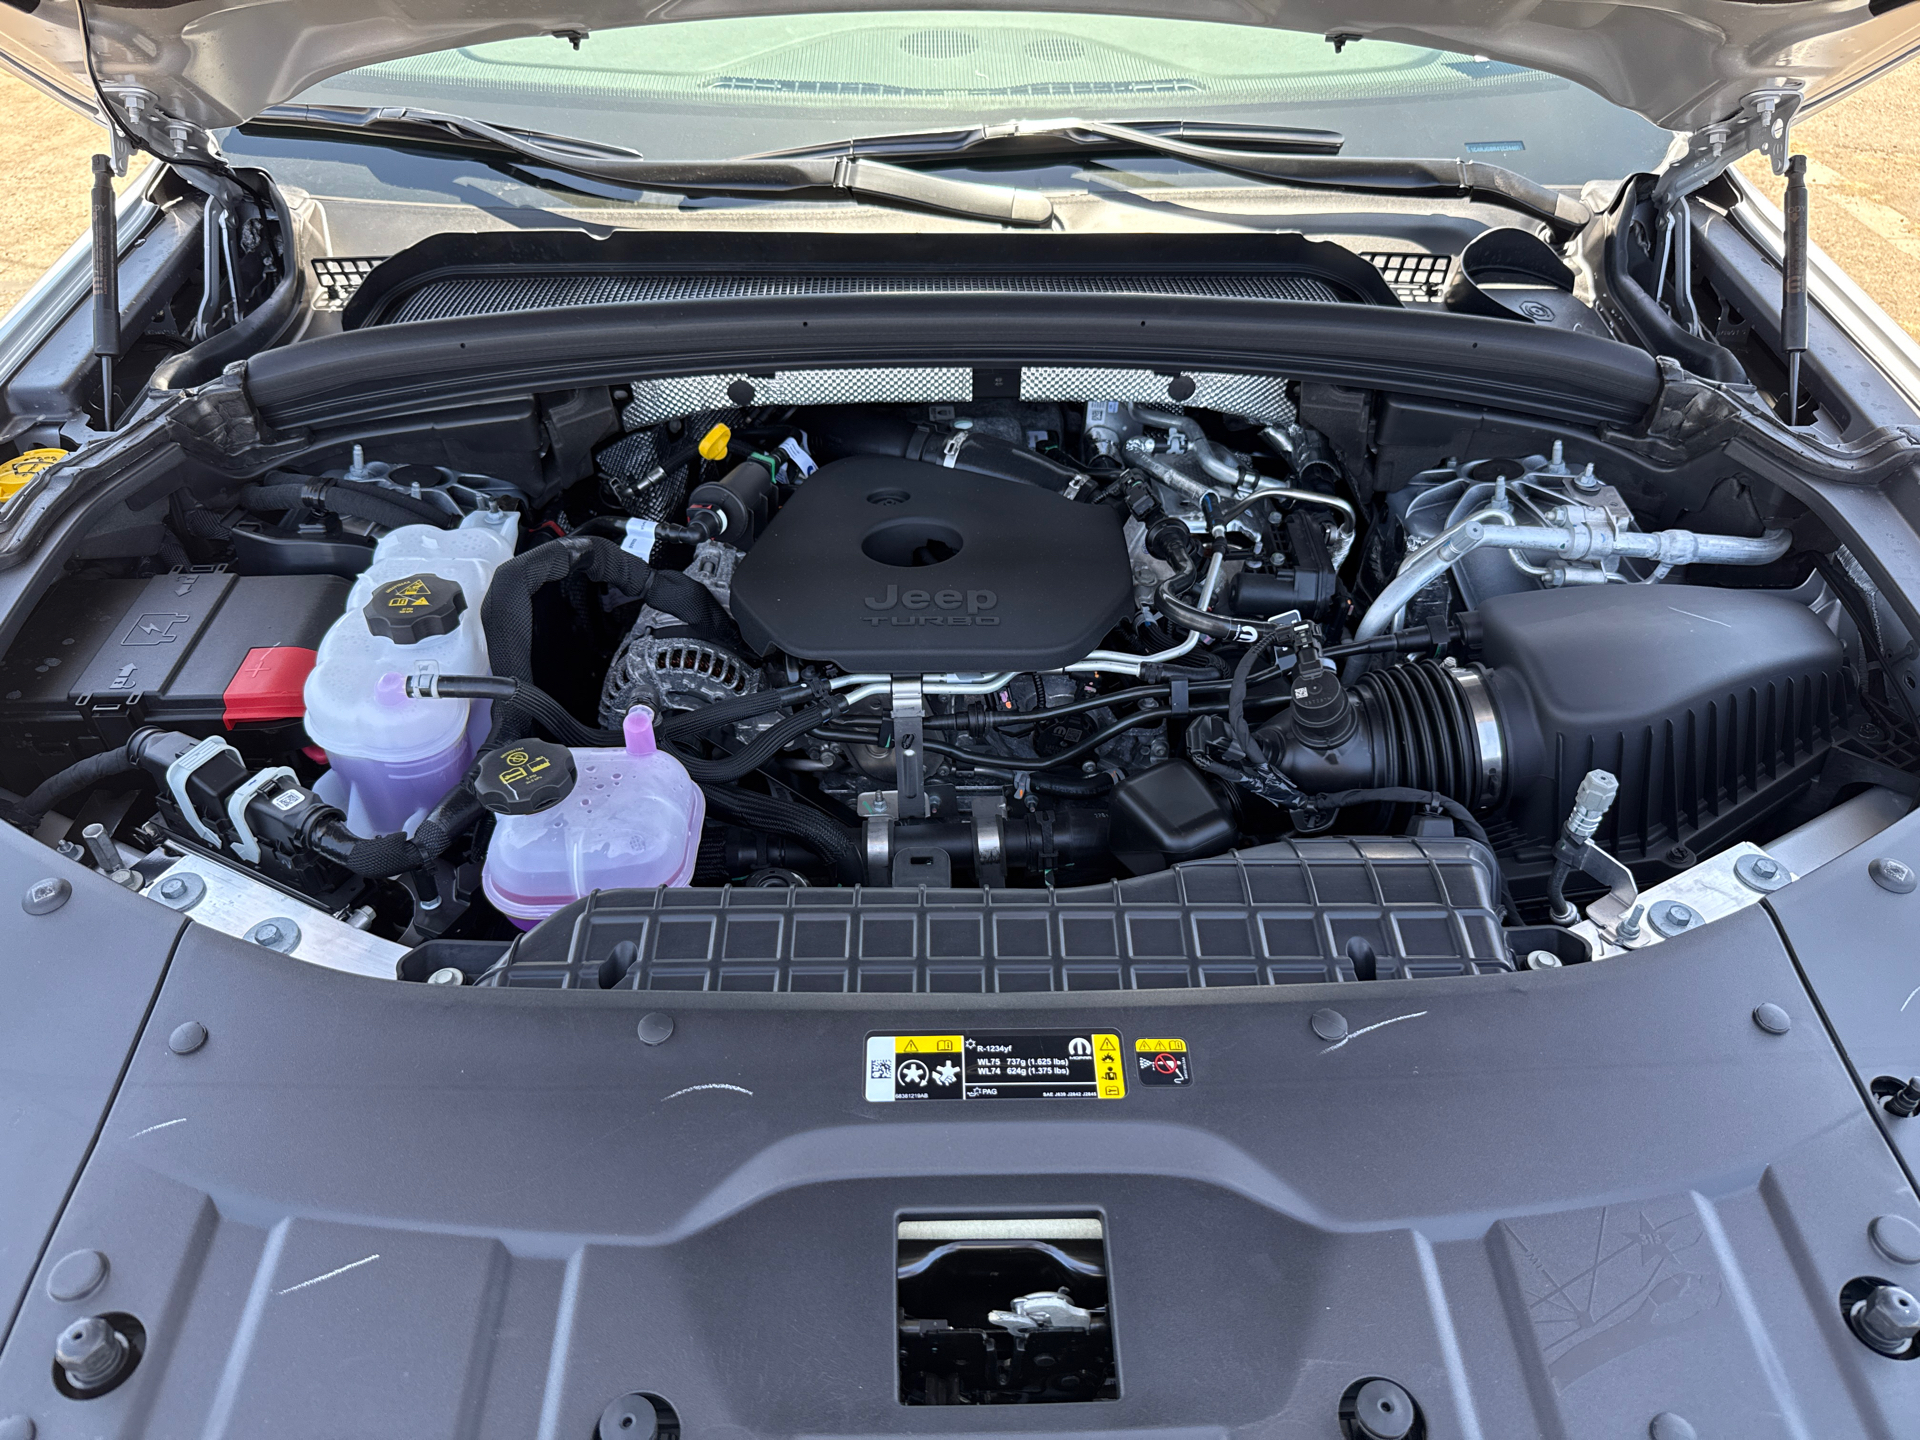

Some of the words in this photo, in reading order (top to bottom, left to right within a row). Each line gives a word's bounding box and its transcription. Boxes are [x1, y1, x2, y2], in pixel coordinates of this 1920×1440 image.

[864, 584, 998, 615] Jeep
[862, 616, 1000, 627] TURBO
[976, 1045, 1012, 1054] R-1234yf
[977, 1058, 1000, 1066] WL75
[1006, 1058, 1026, 1067] 737g
[1027, 1058, 1052, 1067] (1.625
[1053, 1057, 1069, 1067] lbs)
[977, 1067, 1001, 1075] WL74
[1006, 1067, 1026, 1076] 624g
[1027, 1067, 1053, 1076] (1.375
[1053, 1066, 1070, 1076] lbs)
